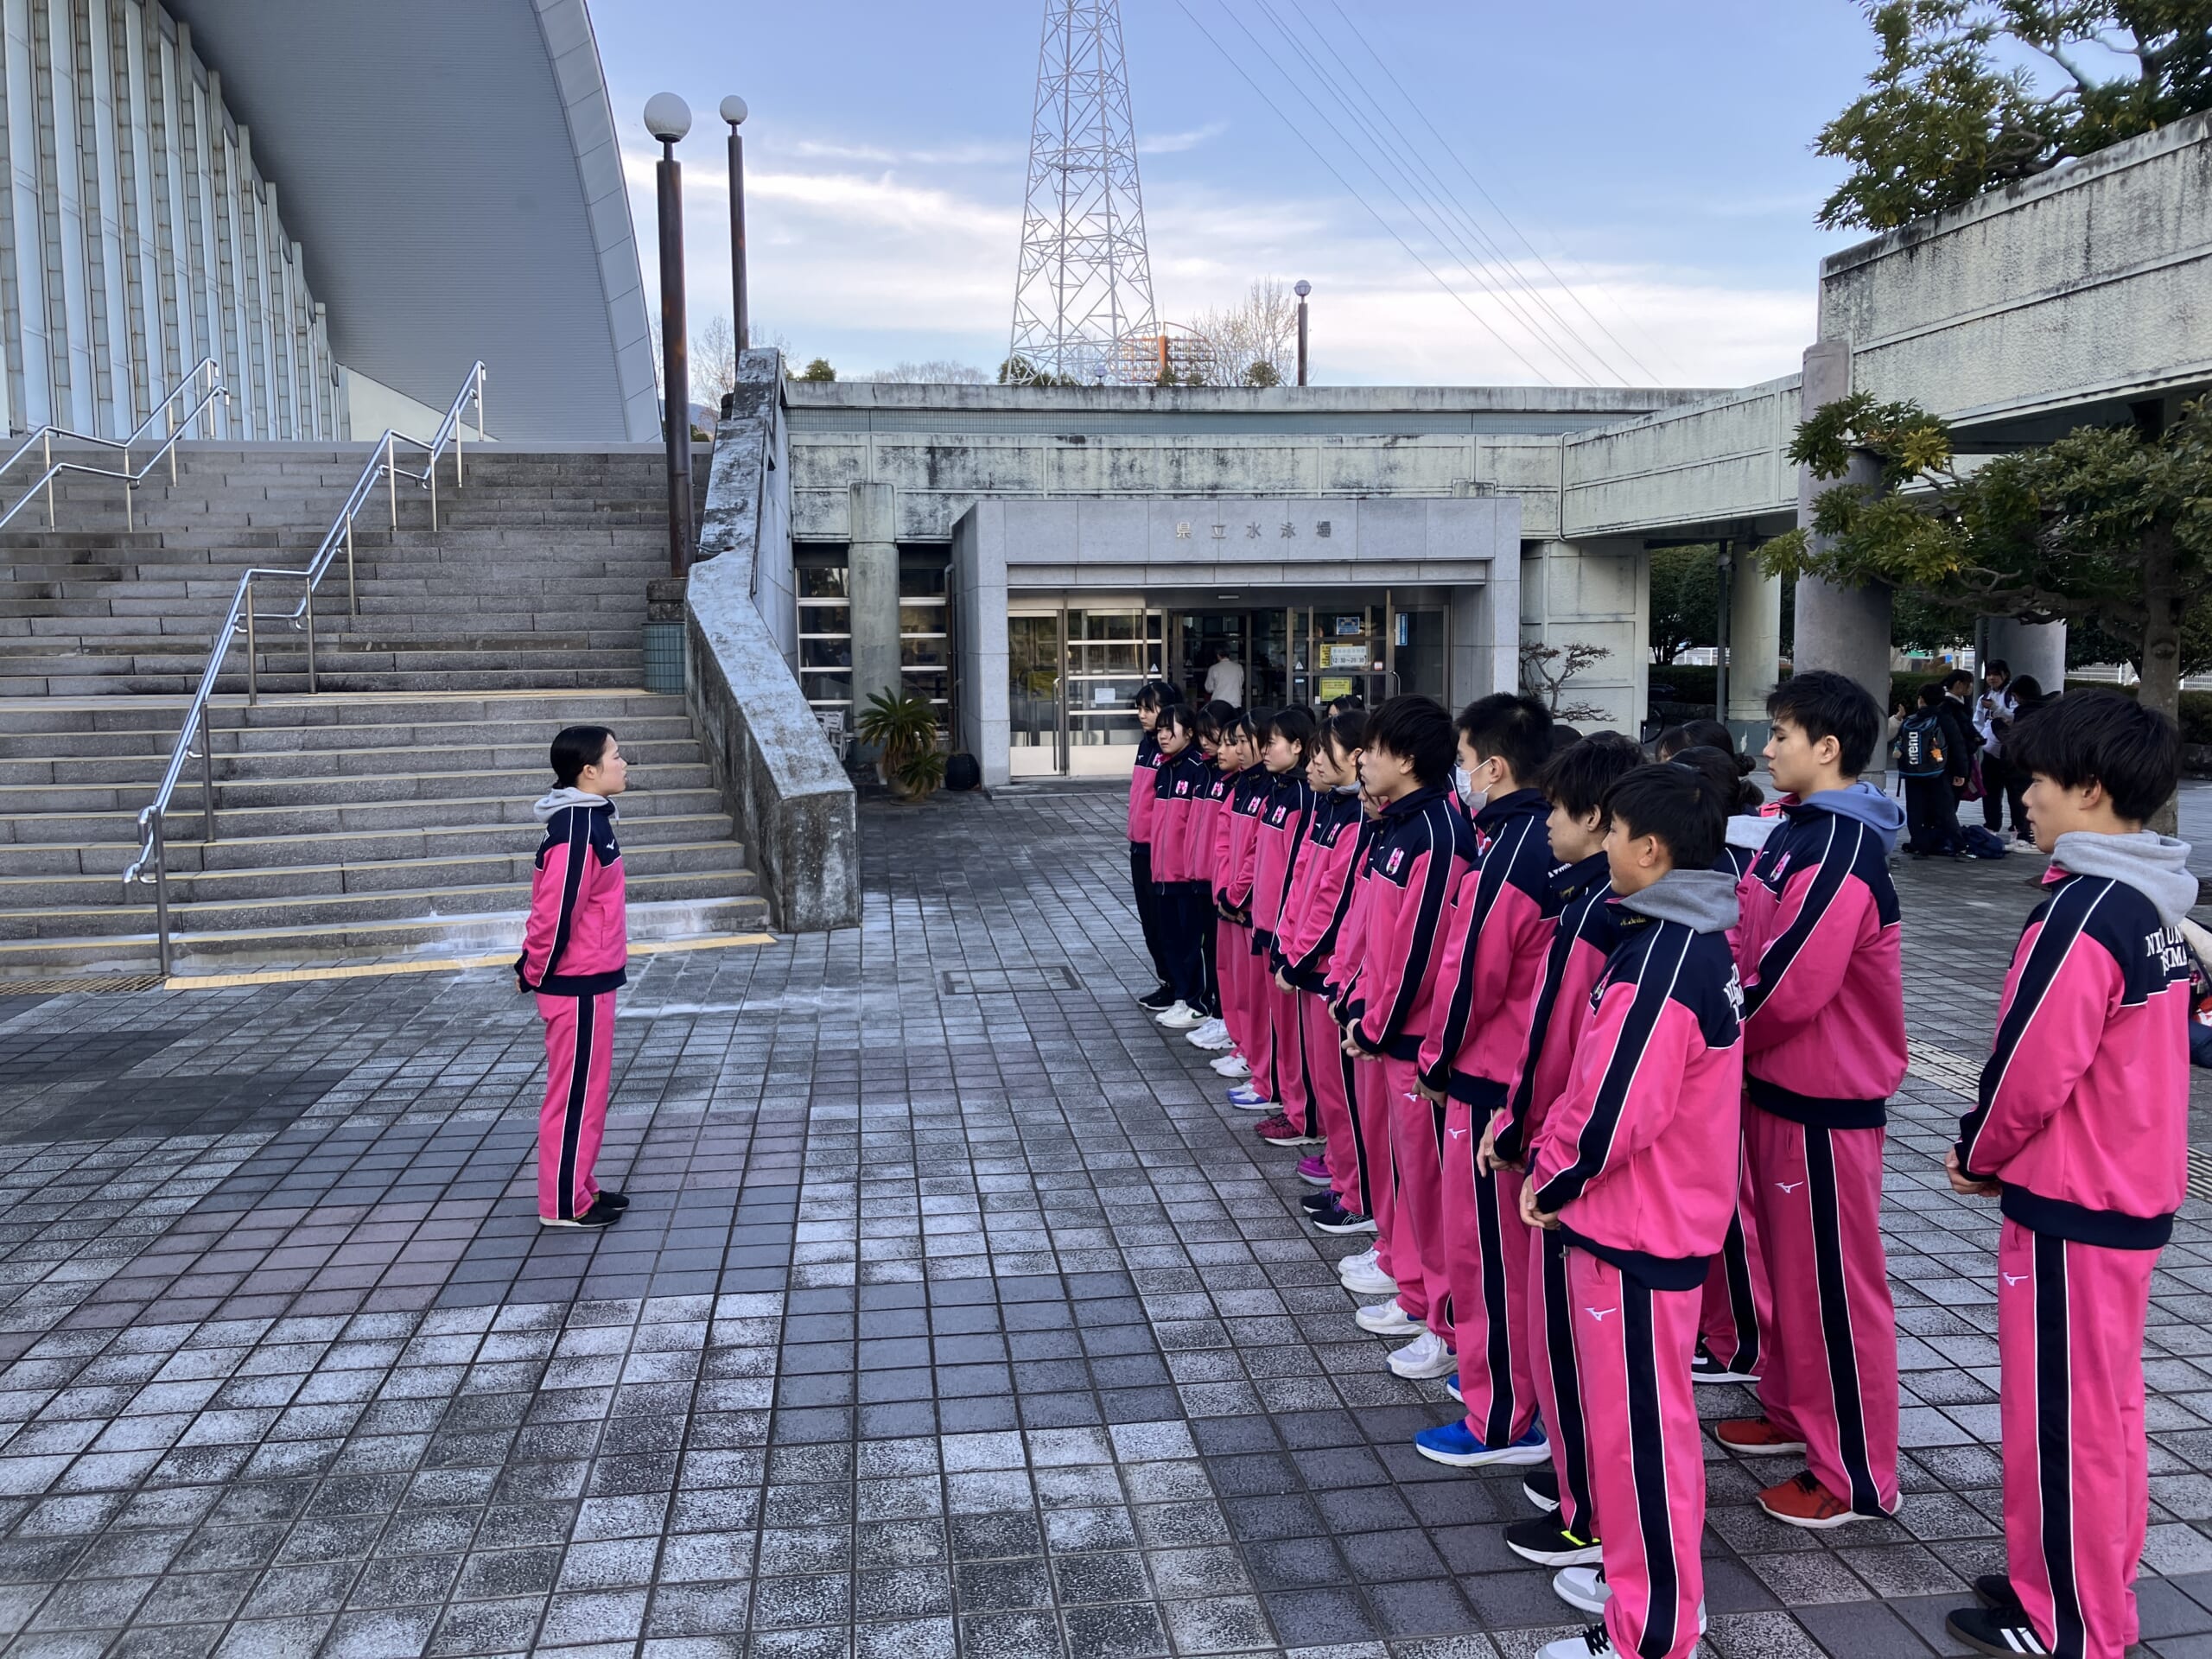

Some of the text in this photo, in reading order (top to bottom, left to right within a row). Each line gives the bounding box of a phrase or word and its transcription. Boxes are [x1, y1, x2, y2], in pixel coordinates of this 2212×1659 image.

[1176, 521, 1332, 539] 県立水泳場
[1909, 732, 1918, 765] arena
